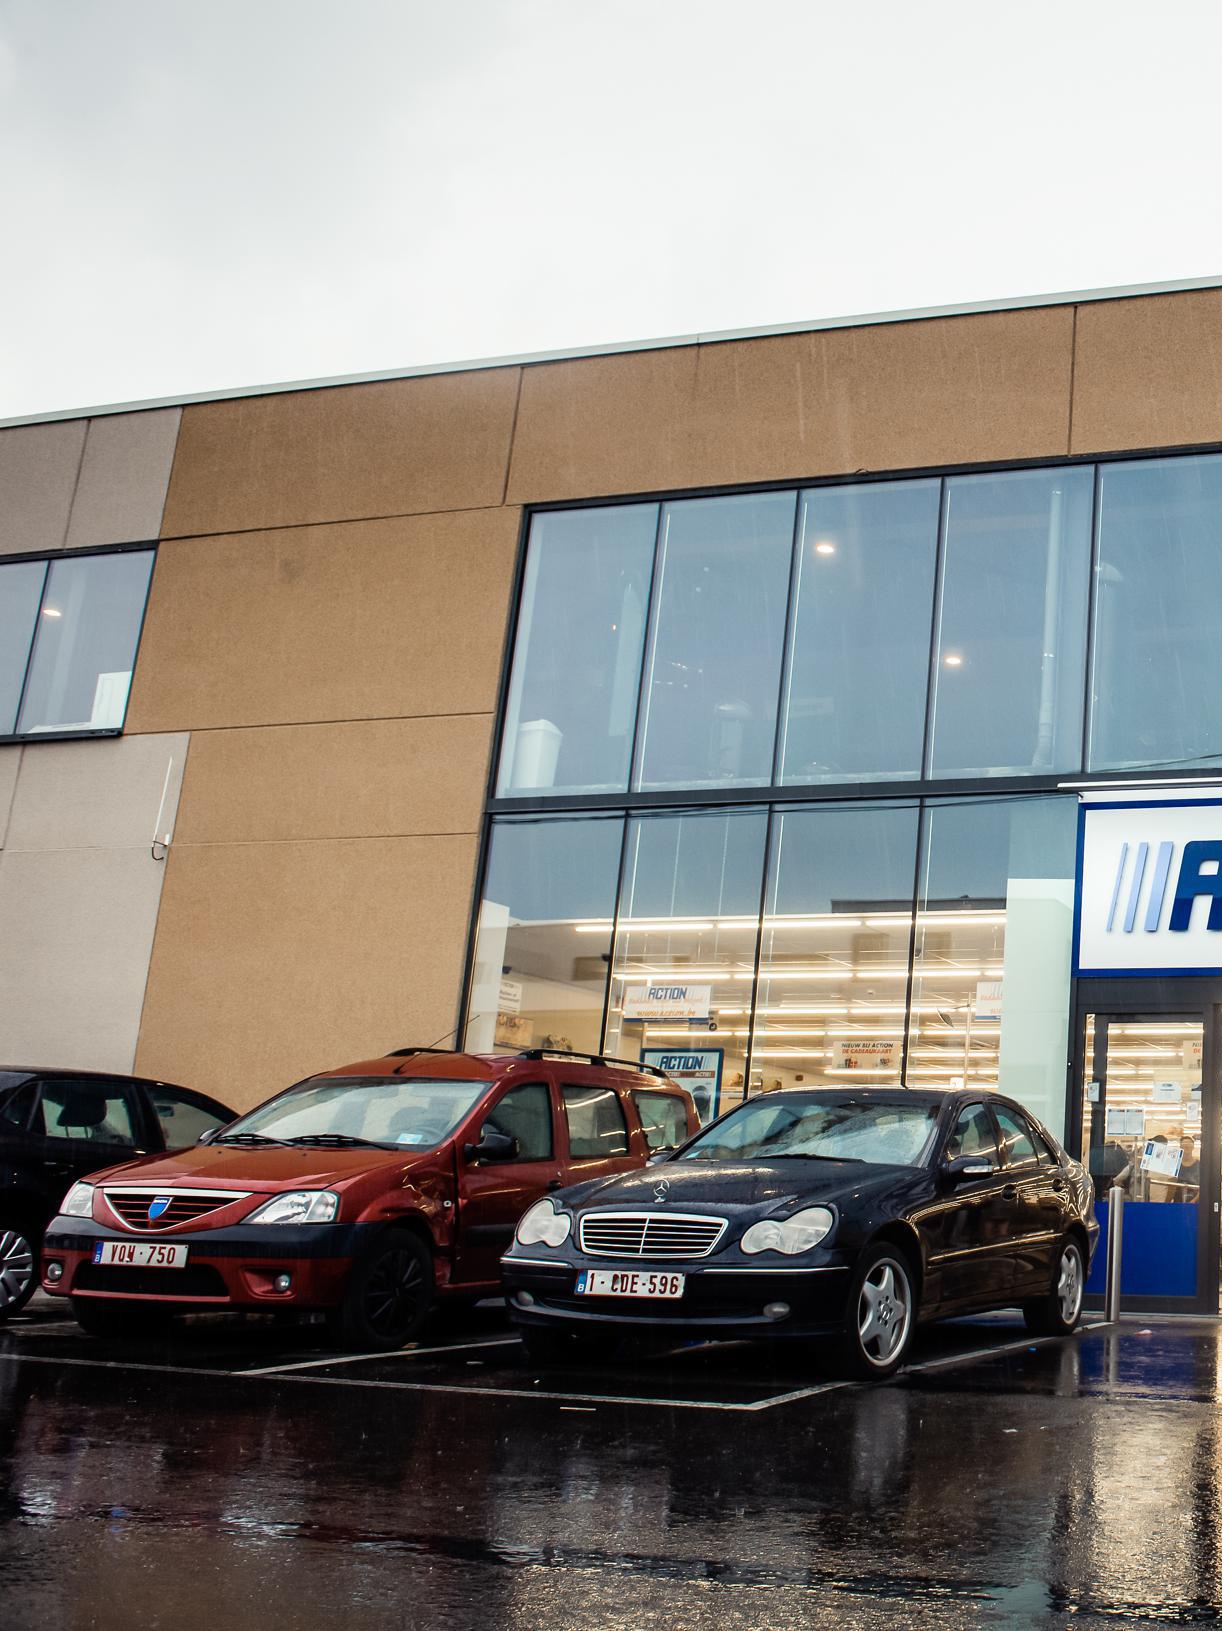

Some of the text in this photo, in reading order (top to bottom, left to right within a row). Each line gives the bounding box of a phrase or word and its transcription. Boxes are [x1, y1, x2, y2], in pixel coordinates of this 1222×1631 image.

[648, 987, 688, 1000] ACTION
[659, 1056, 704, 1070] ACTION
[577, 1284, 585, 1292] B
